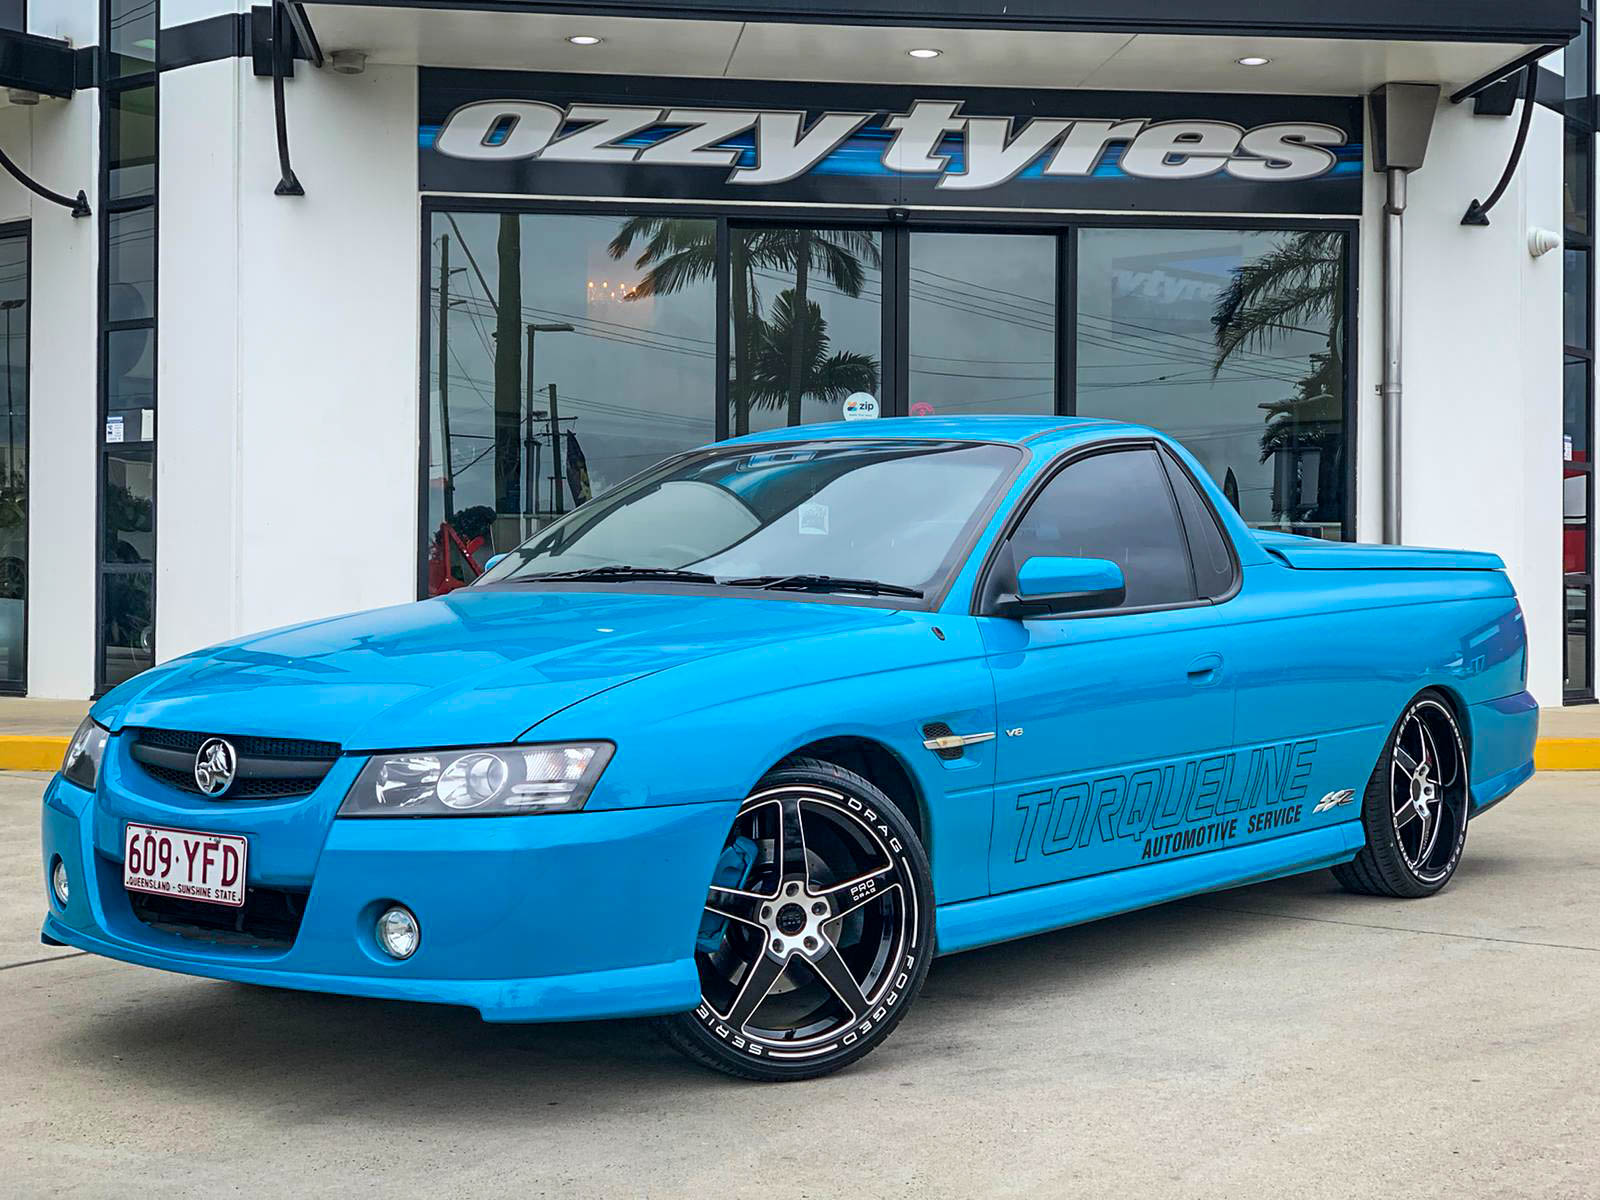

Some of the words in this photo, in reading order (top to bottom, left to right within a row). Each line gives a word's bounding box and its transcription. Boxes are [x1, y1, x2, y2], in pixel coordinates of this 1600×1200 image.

[434, 98, 877, 186] ozzy
[883, 98, 1349, 191] tyres
[859, 401, 874, 411] zip
[847, 797, 903, 853] DRAG
[1014, 739, 1318, 864] TORQUELINE
[1142, 819, 1237, 860] AUTOMOTIVE
[1247, 804, 1302, 834] SERVICE
[128, 876, 170, 892] QUEENSLAND
[177, 883, 212, 898] SUNSHINE
[214, 888, 237, 902] STATE
[850, 878, 875, 896] PRO
[843, 953, 915, 1046] FORGED
[696, 1003, 763, 1056] SERIE
